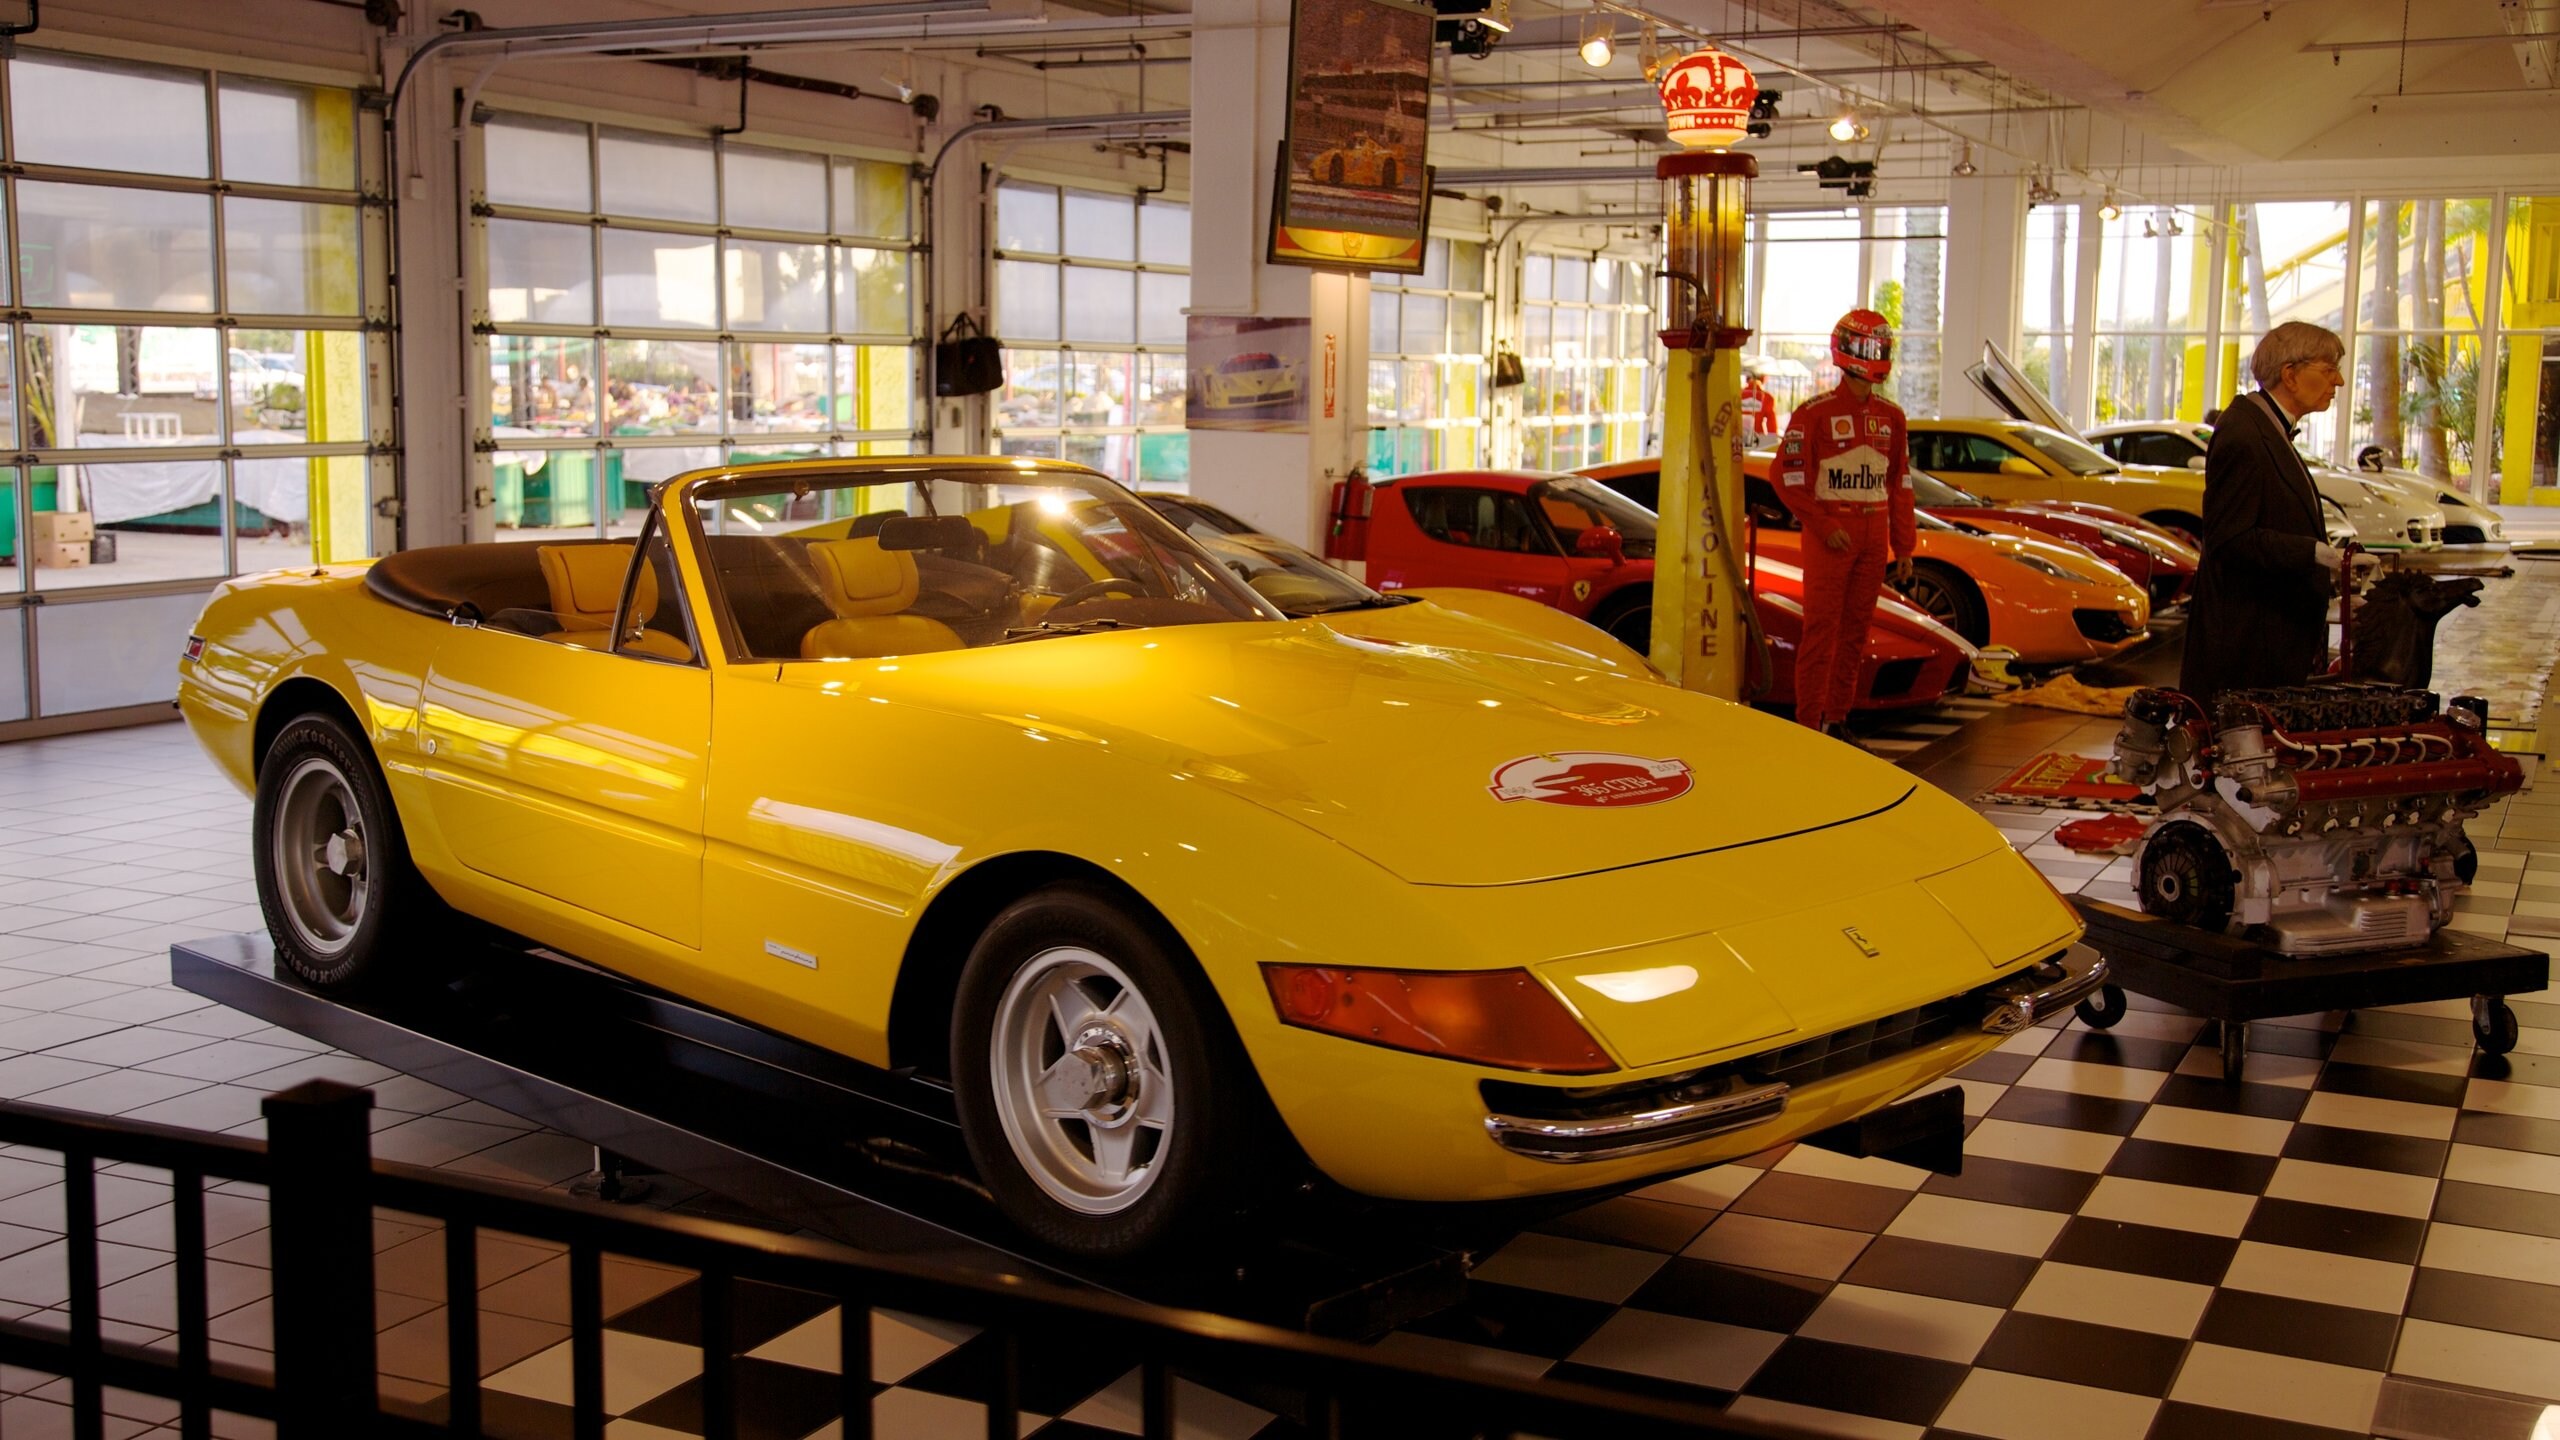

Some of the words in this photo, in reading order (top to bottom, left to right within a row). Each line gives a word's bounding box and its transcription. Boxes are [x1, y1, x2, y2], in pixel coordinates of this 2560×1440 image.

[1711, 401, 1732, 438] RED
[1828, 464, 1886, 490] Marlbor
[1569, 782, 1610, 797] 365
